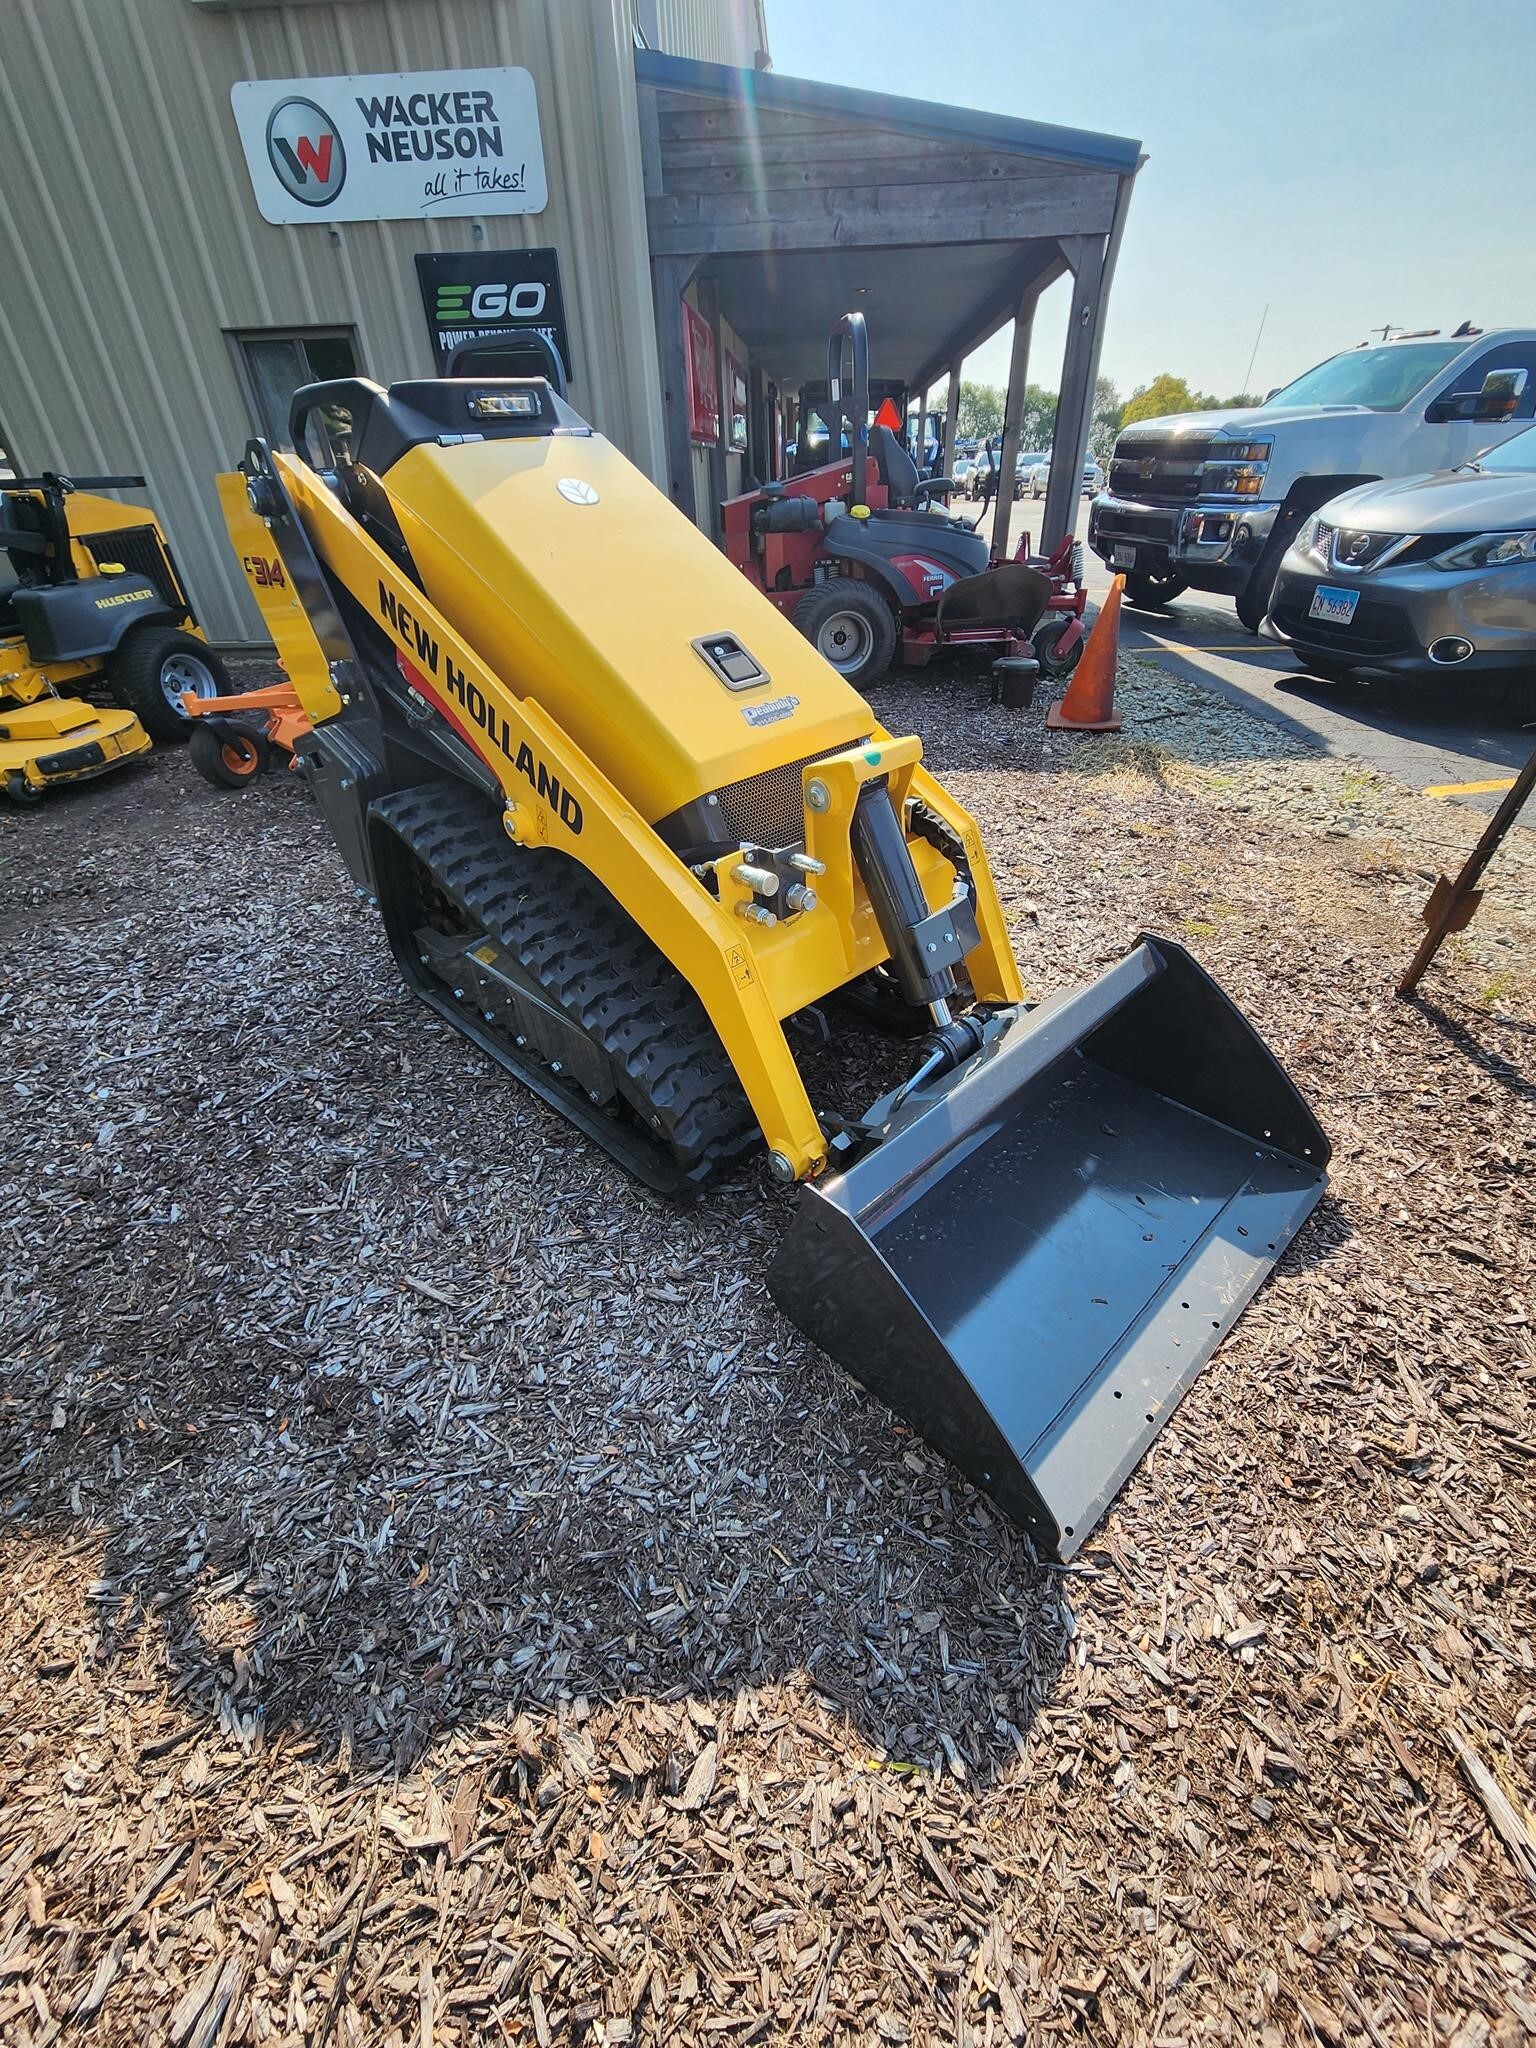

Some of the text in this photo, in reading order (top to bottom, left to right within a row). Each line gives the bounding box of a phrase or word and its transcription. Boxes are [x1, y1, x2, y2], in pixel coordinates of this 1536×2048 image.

[355, 91, 499, 128] WACKER
[366, 126, 503, 163] NEUSON
[424, 164, 526, 196] all it takes!
[436, 282, 546, 320] EGO
[923, 574, 943, 582] FERRIS
[95, 589, 154, 609] HUSTLER
[378, 578, 583, 835] NEW HOLLAND
